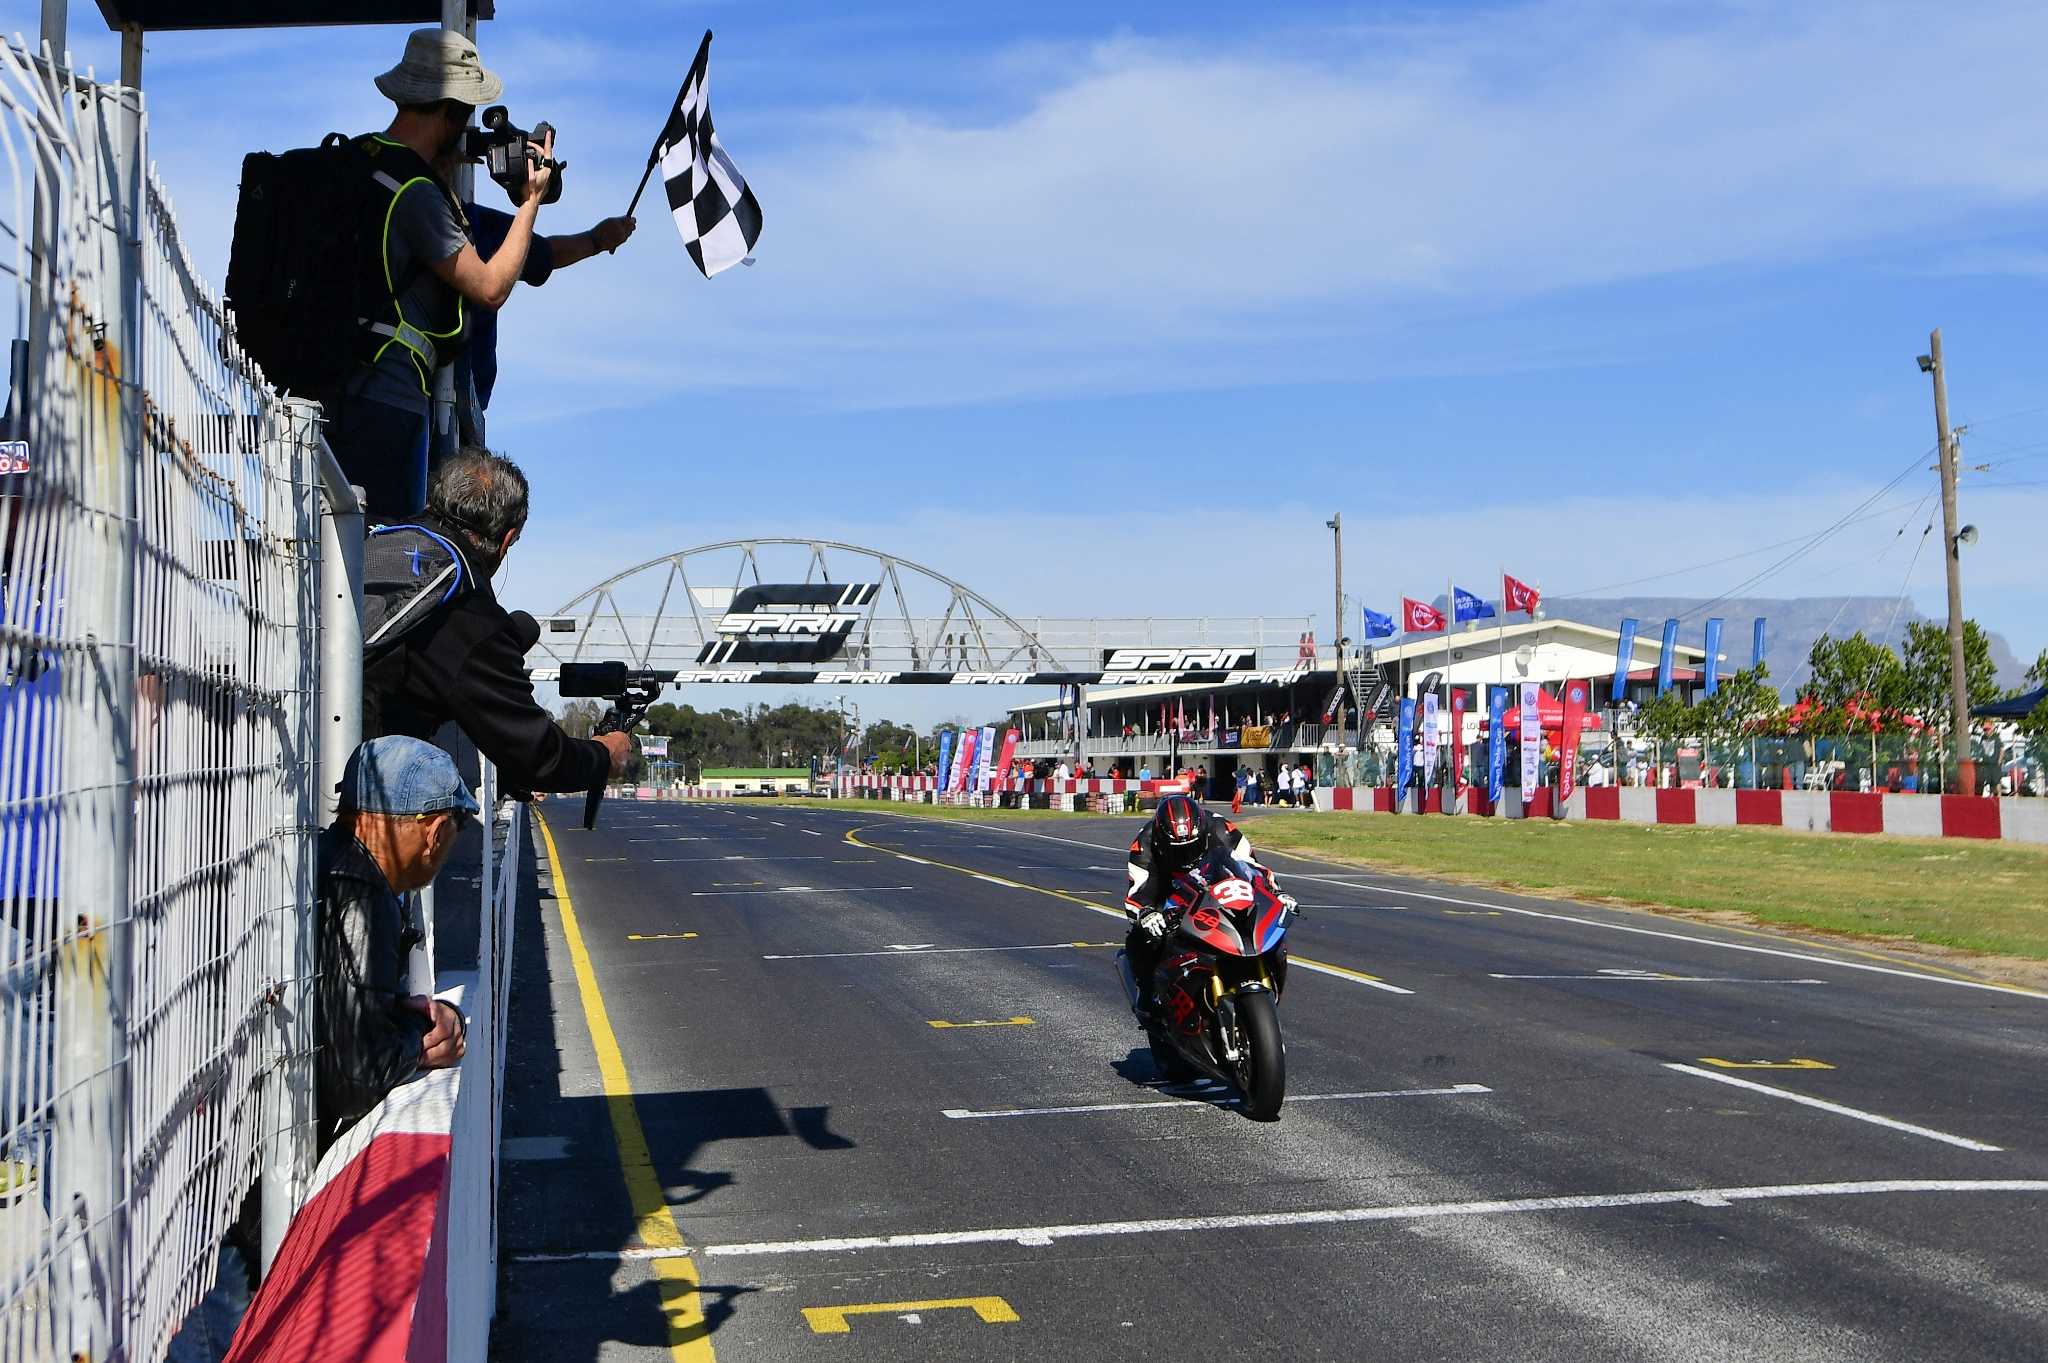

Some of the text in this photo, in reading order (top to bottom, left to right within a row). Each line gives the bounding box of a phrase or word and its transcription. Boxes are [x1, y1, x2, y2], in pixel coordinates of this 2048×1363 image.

[715, 613, 861, 633] SPIRIT
[1104, 649, 1255, 670] SPIRIT
[673, 670, 762, 683] SPIRIT
[813, 671, 902, 684] SPIRIT
[949, 672, 1037, 684] SPIRIT
[1098, 672, 1185, 684] SPIRIT
[1223, 671, 1310, 684] SPIRIT
[1213, 879, 1254, 905] 38
